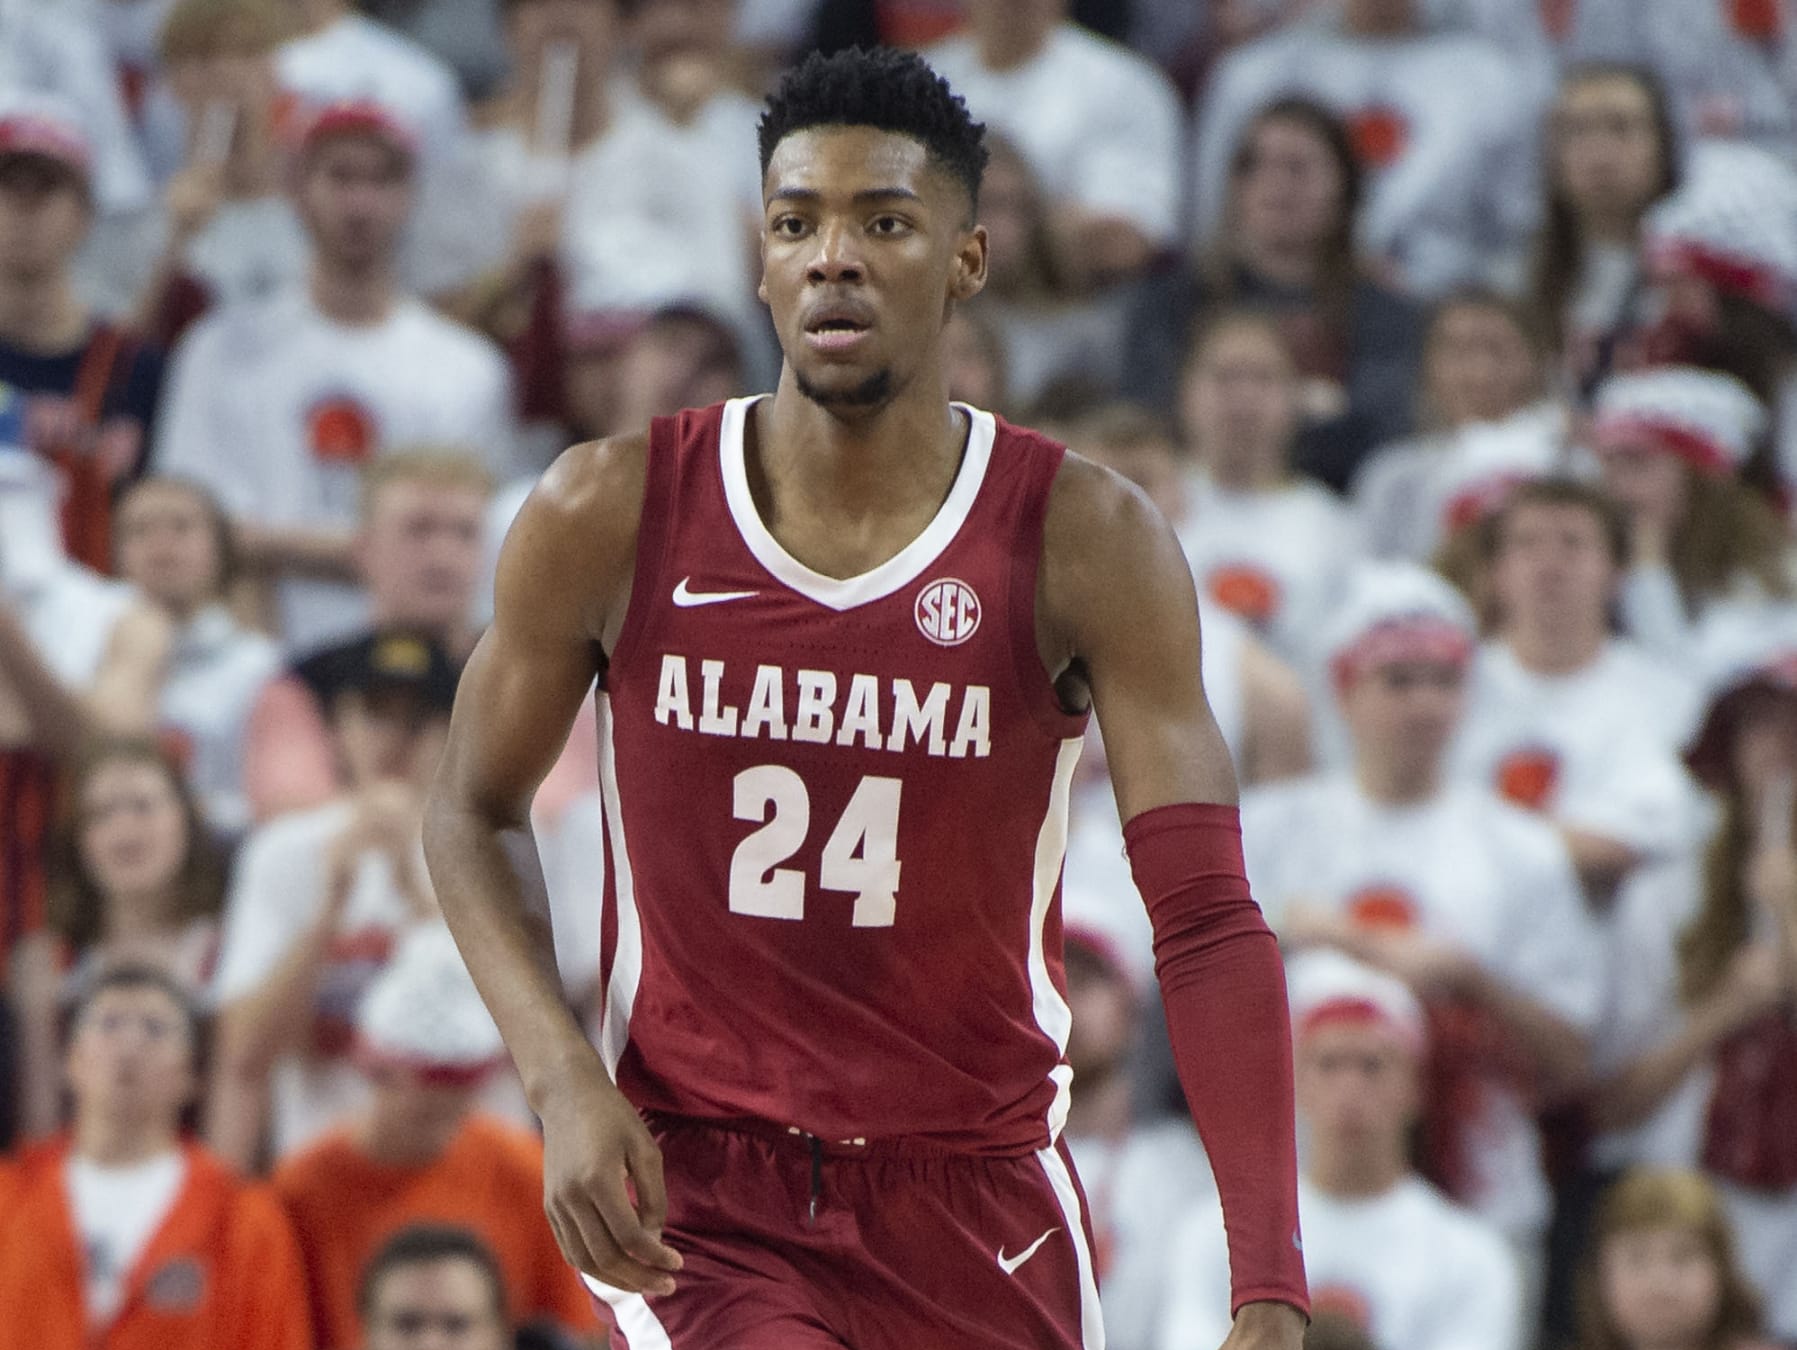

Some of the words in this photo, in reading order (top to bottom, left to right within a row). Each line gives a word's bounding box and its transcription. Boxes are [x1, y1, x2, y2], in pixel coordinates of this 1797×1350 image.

[921, 582, 977, 641] SEC
[654, 653, 992, 758] ALABAMA
[728, 764, 903, 928] 24
